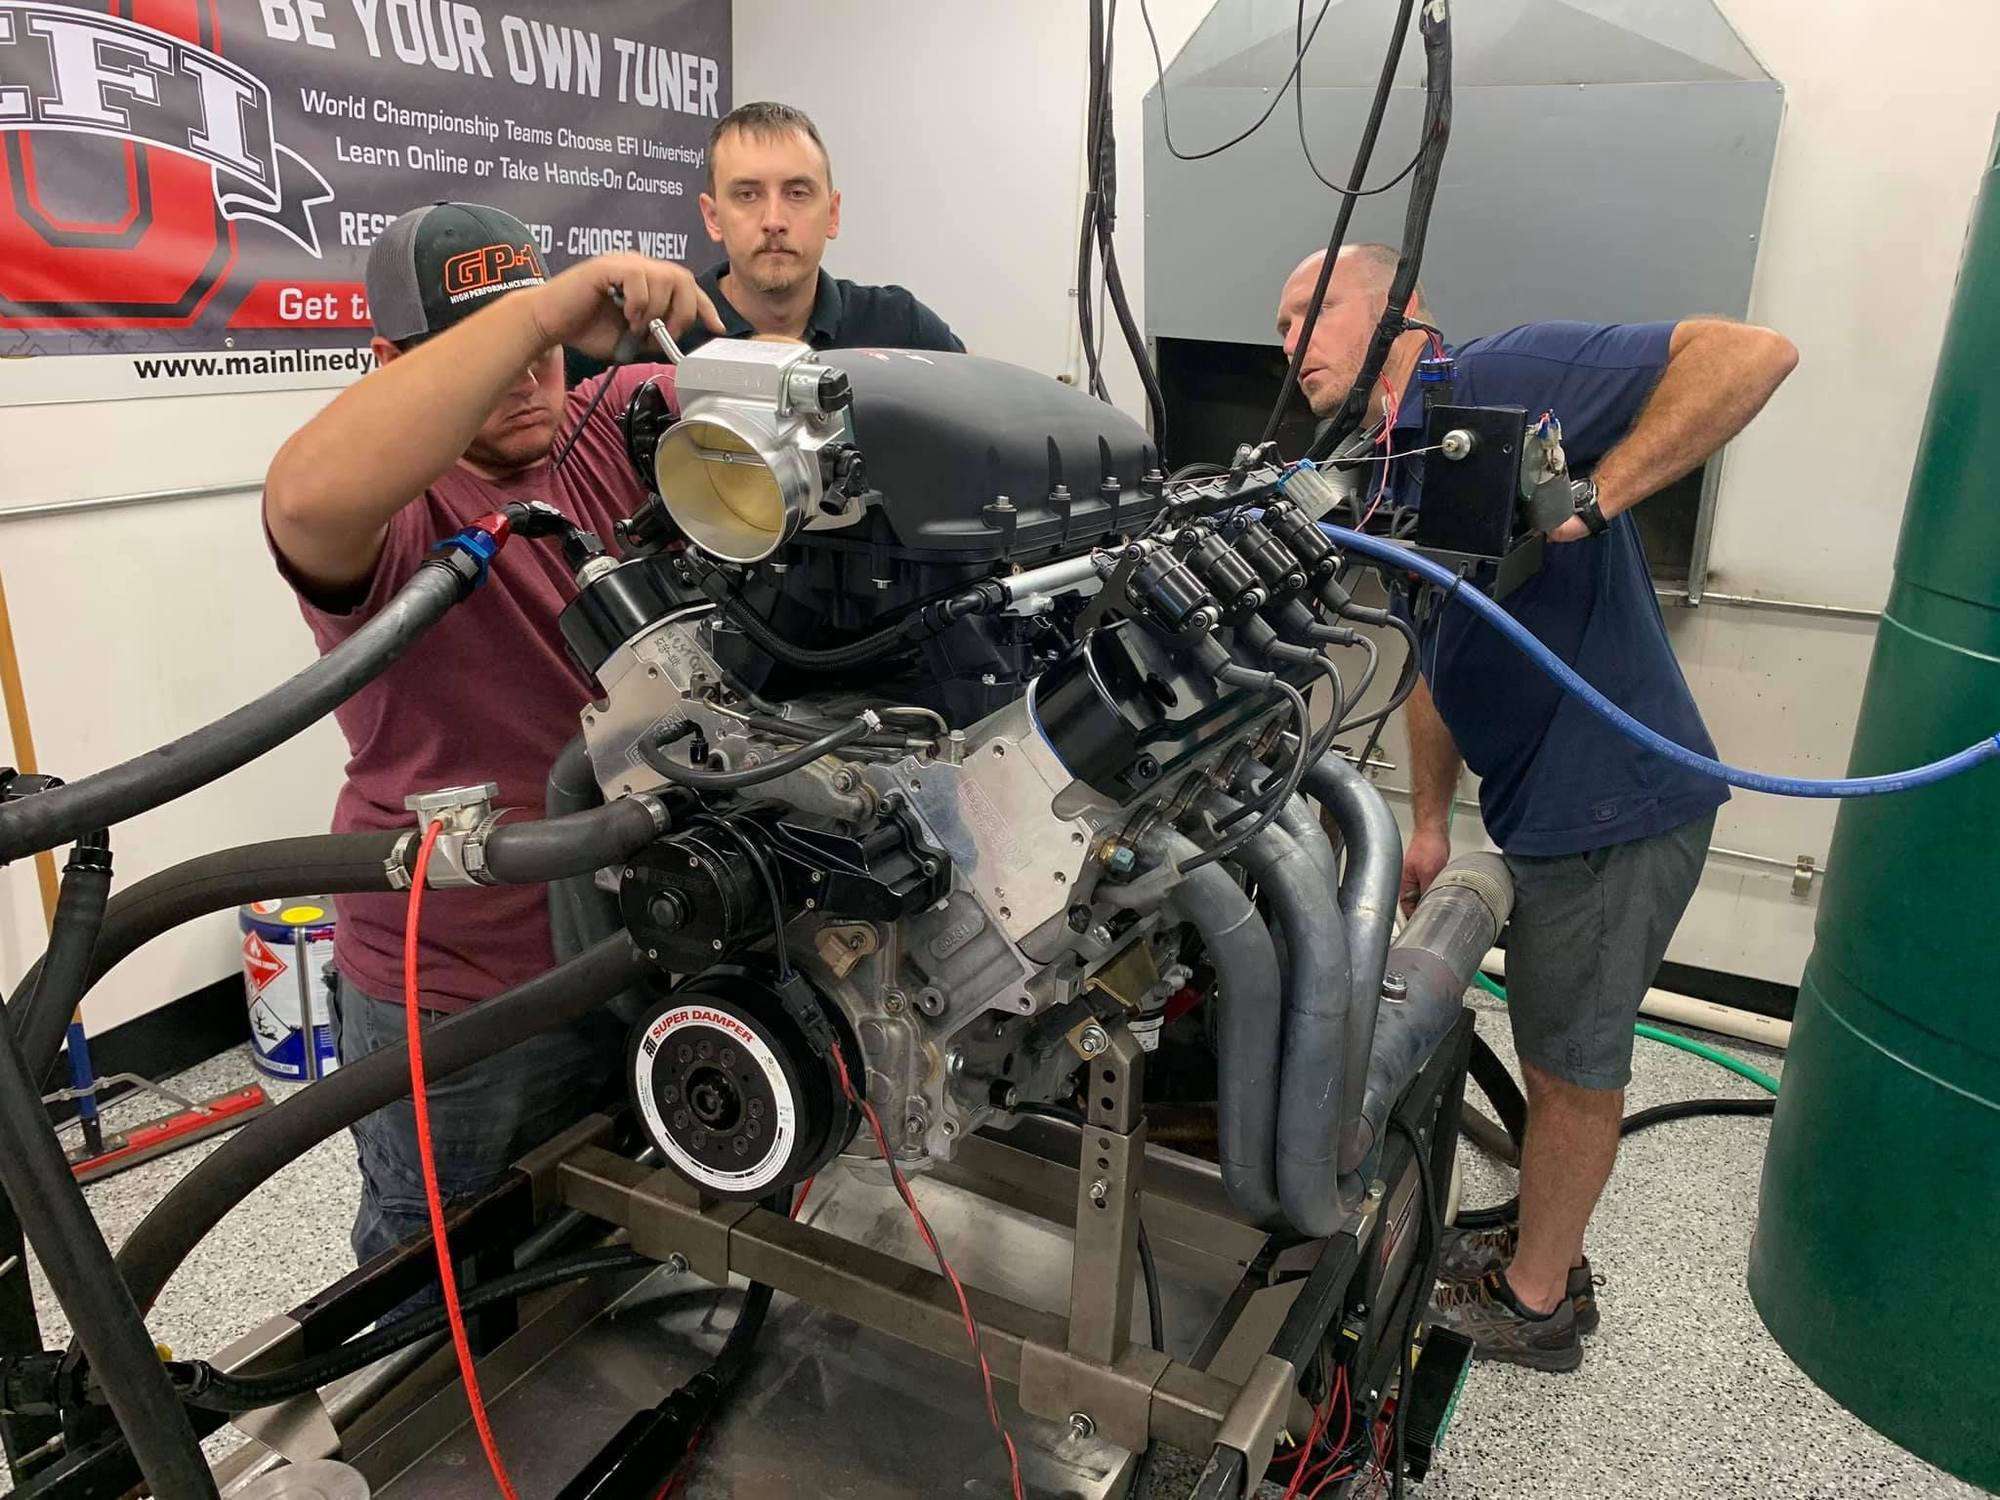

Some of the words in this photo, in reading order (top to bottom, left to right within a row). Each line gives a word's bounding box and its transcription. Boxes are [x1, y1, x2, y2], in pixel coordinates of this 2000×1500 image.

[258, 0, 337, 49] BE
[350, 0, 494, 78] YOUR
[500, 15, 601, 98] OWN
[613, 37, 720, 119] TUNER
[0, 7, 267, 182] FI
[300, 88, 366, 120] World
[373, 99, 500, 143] Championship
[504, 119, 553, 146] Teams
[557, 127, 613, 153] Choose
[616, 135, 639, 156] EFI
[643, 138, 705, 170] Univeristy!
[336, 136, 401, 168] Learn
[407, 145, 468, 175] Online
[474, 159, 494, 177] or
[499, 156, 540, 182] Take
[544, 161, 623, 190] Hands-On
[626, 171, 684, 196] Courses
[445, 243, 542, 294] GP-1
[568, 226, 633, 255] CHOOSE
[638, 230, 688, 260] WISELY
[279, 287, 338, 320] Get
[351, 292, 372, 320] t
[449, 292, 470, 304] HIGH
[469, 280, 522, 300] PERFORMANCE
[652, 1010, 689, 1040] SUPER
[692, 1010, 754, 1043] DAMPER
